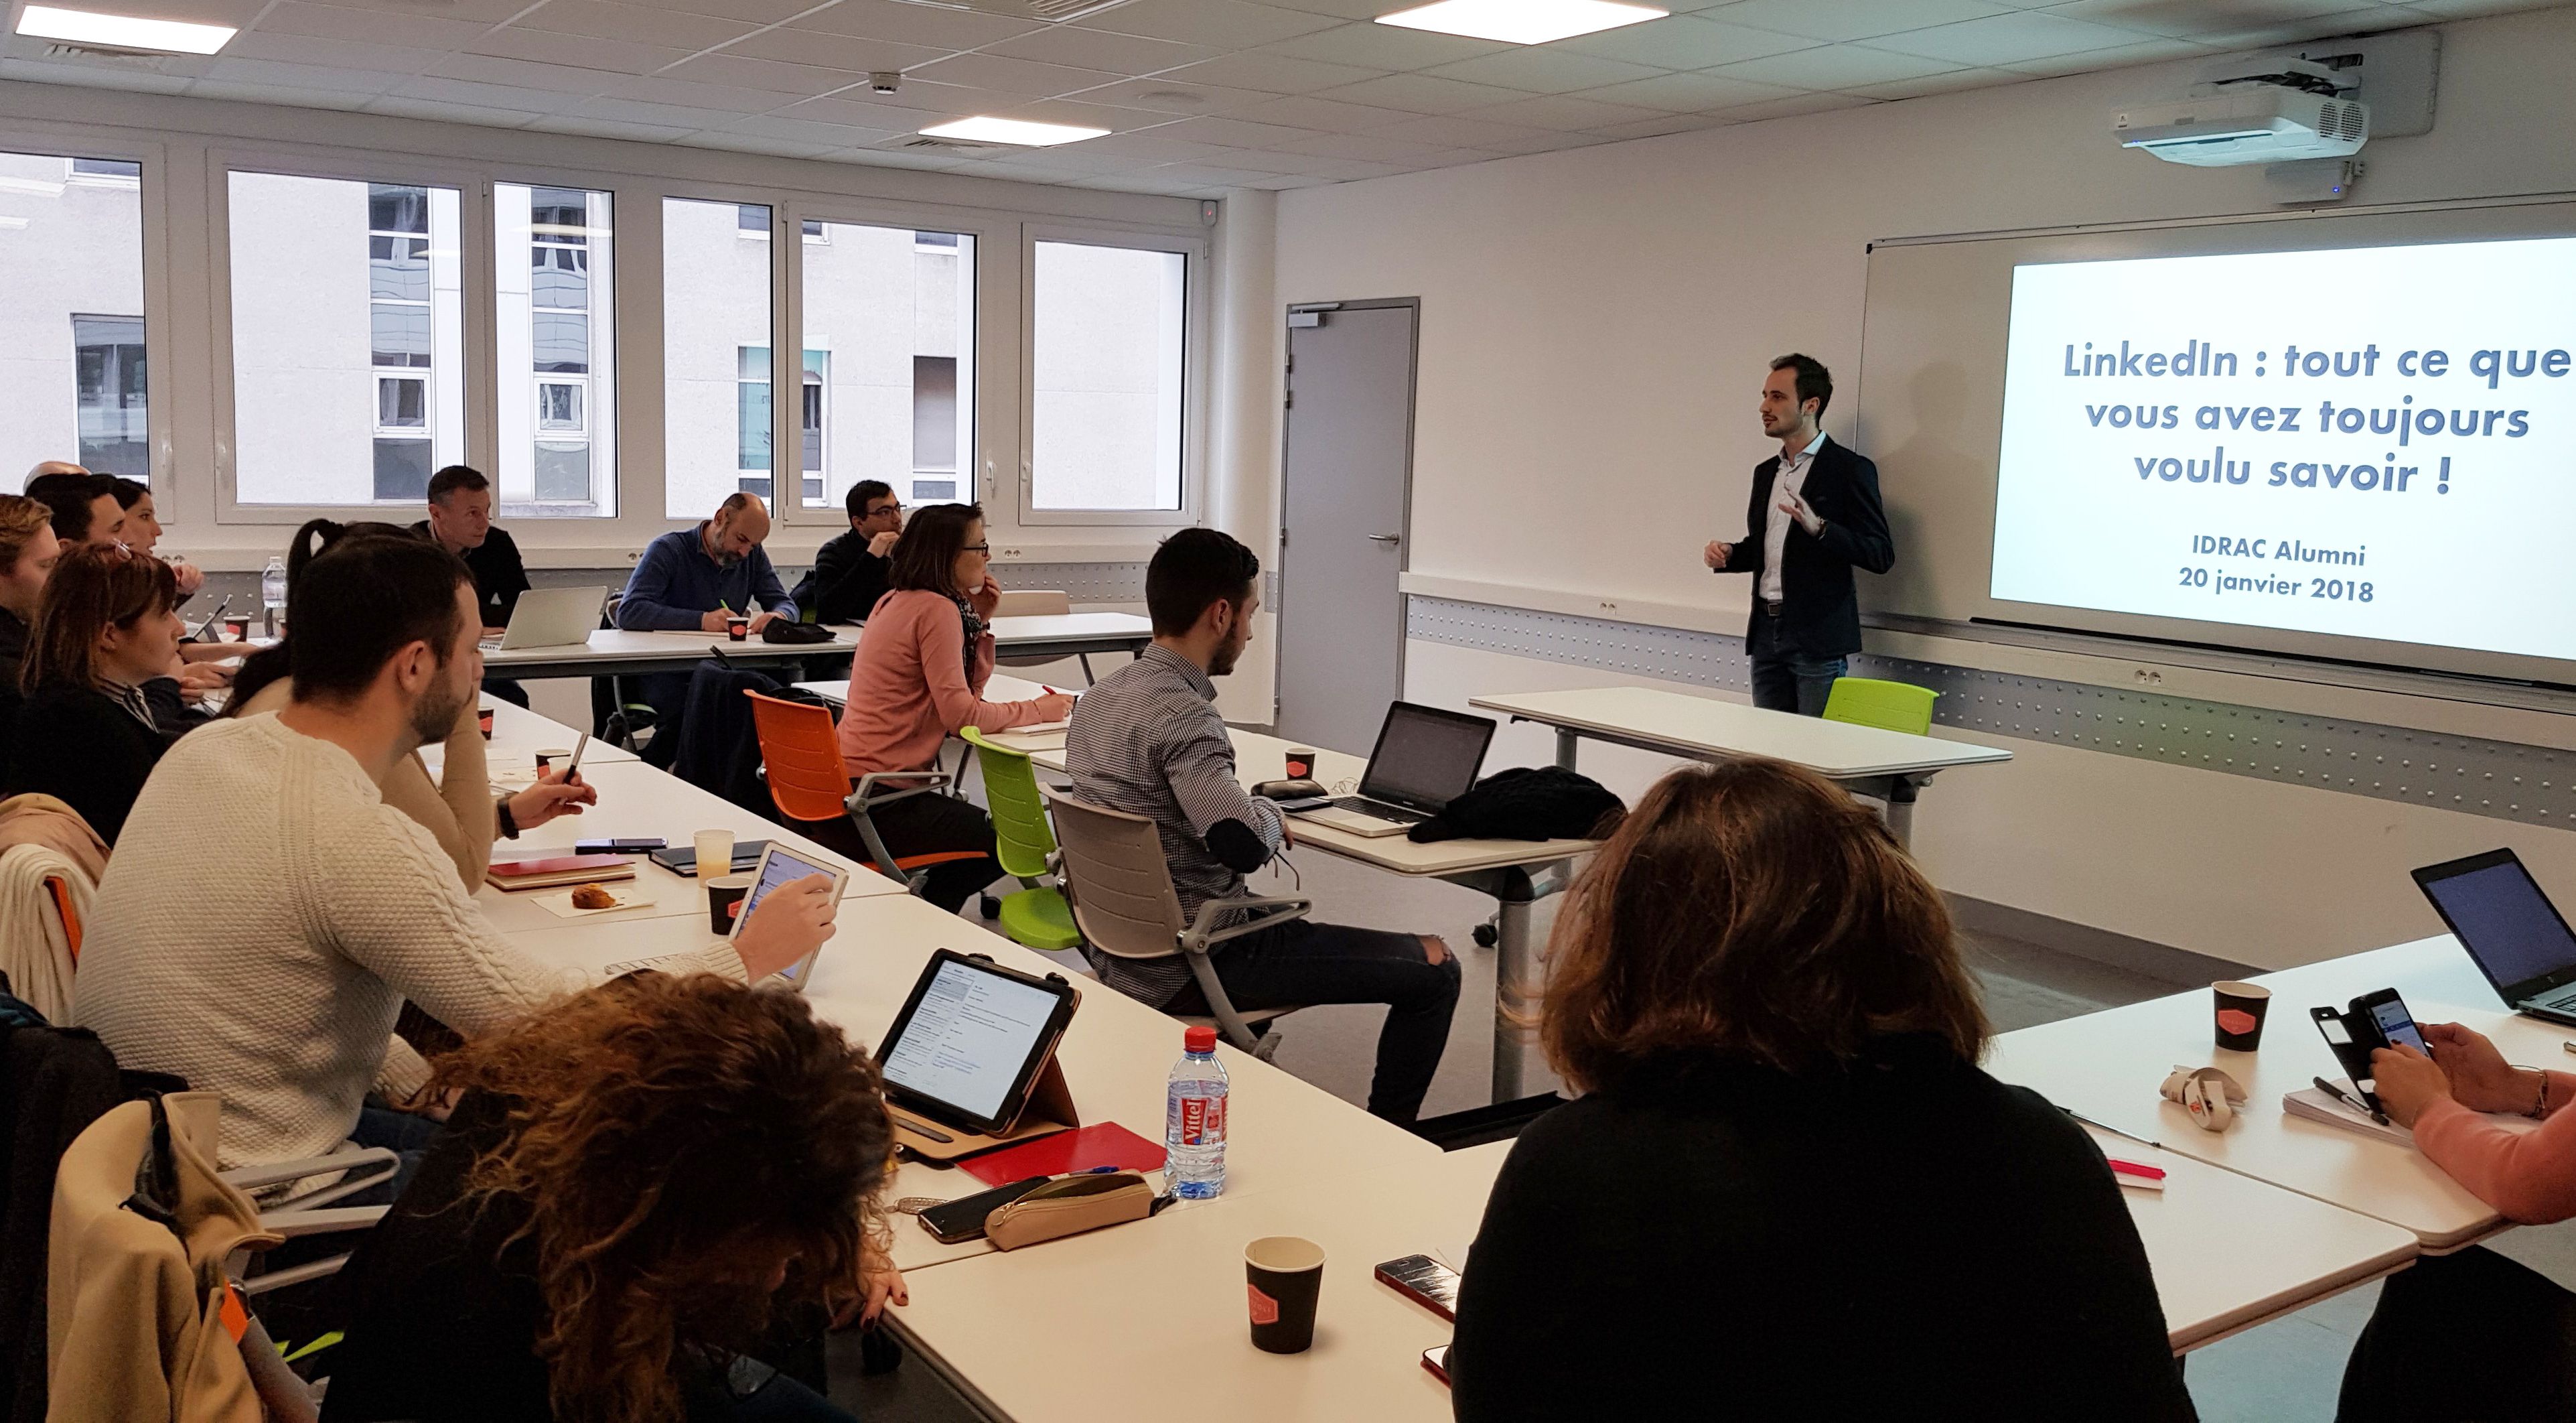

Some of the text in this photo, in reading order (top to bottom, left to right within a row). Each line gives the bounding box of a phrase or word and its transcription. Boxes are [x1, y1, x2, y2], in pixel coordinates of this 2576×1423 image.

[2064, 339, 2571, 390] LinkedIn : tout ce que
[2084, 395, 2530, 447] vous avez toujours
[2133, 446, 2451, 495] voulu savoir !
[2192, 535, 2366, 567] IDRAC Alumni
[2178, 567, 2374, 603] 20 janvier 2018
[1185, 1097, 1202, 1140] Vittel
